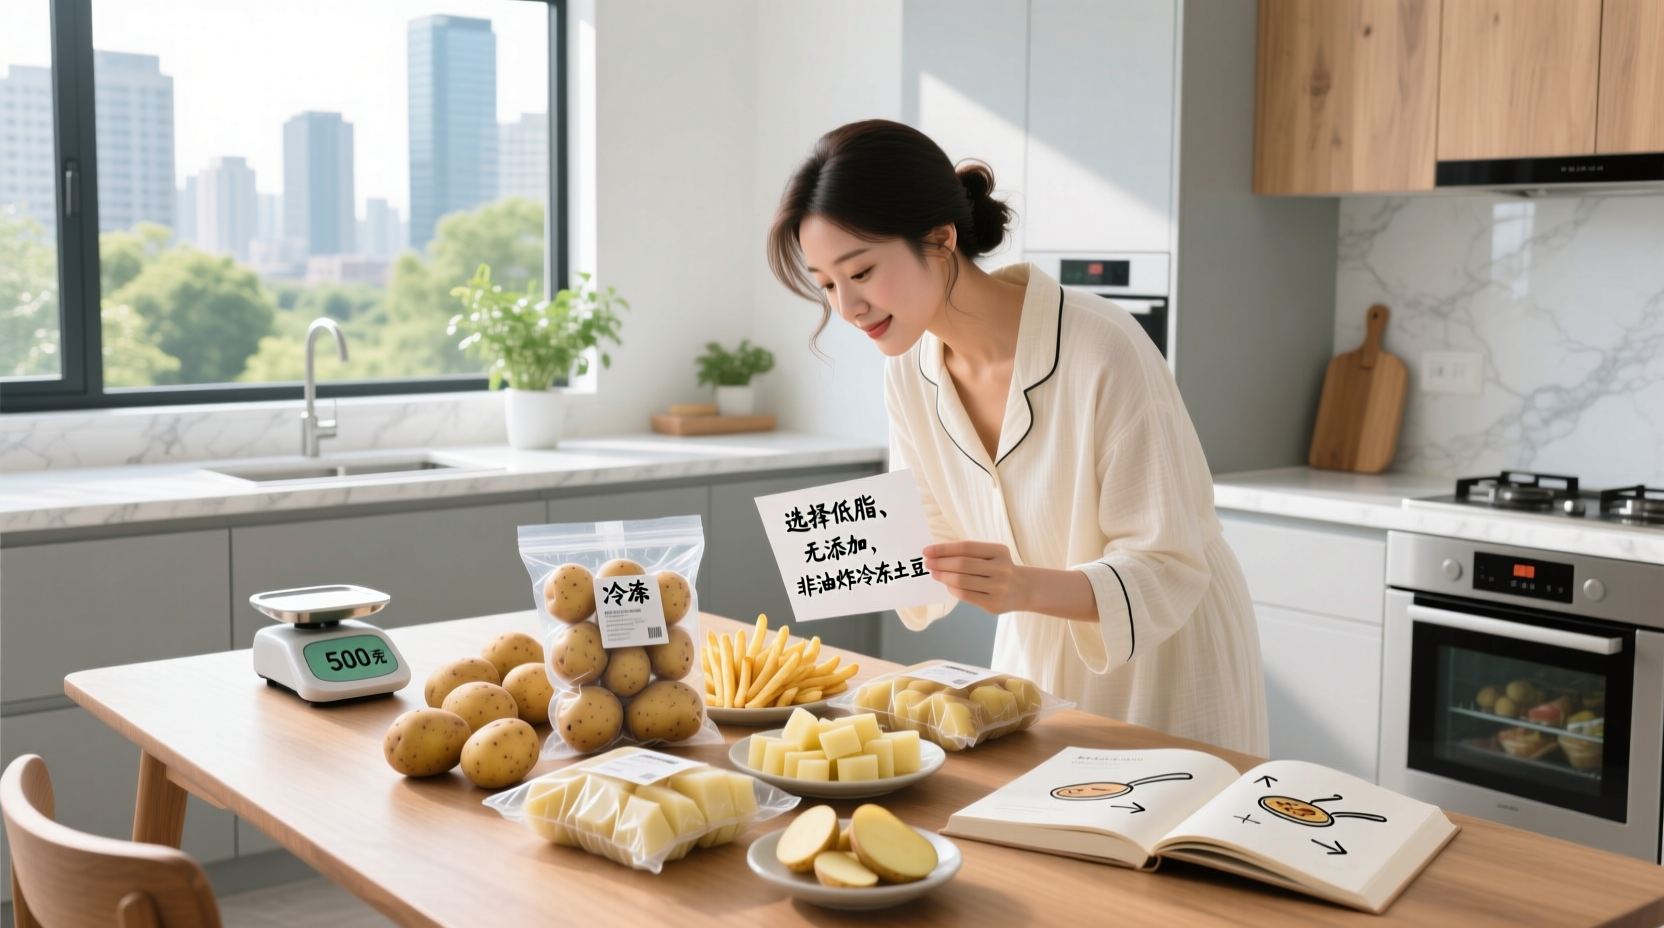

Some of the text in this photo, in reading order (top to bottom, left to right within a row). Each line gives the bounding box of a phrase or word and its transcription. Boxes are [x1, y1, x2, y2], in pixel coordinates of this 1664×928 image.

[785, 494, 887, 532] 选择低脂、
[797, 557, 930, 597] 非油炸冷冻土豆
